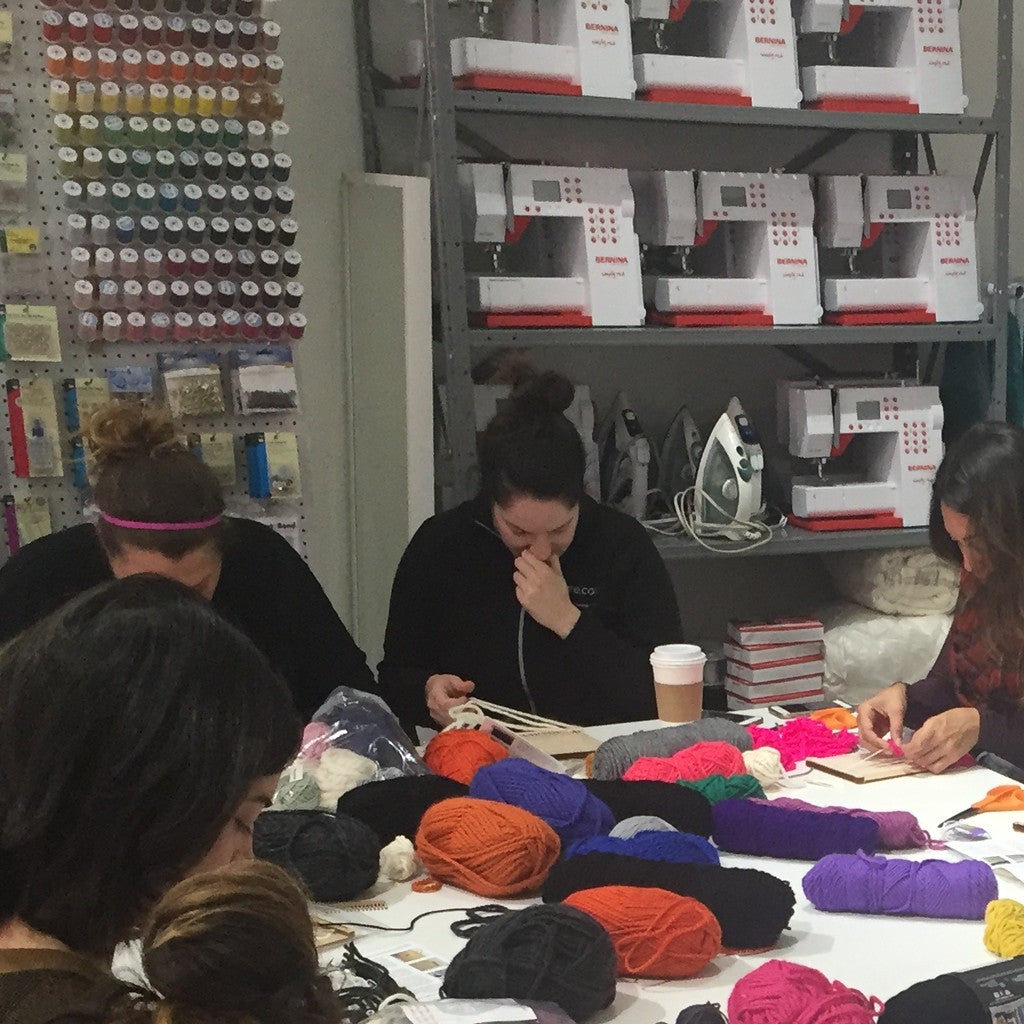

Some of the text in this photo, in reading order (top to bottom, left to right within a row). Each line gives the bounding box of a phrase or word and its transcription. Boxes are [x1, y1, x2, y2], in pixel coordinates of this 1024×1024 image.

[585, 23, 619, 33] BERNINA
[755, 36, 786, 45] BERNINA
[923, 45, 953, 53] BERNINA
[595, 256, 628, 265] BERNINA
[940, 257, 970, 265] BERNINA
